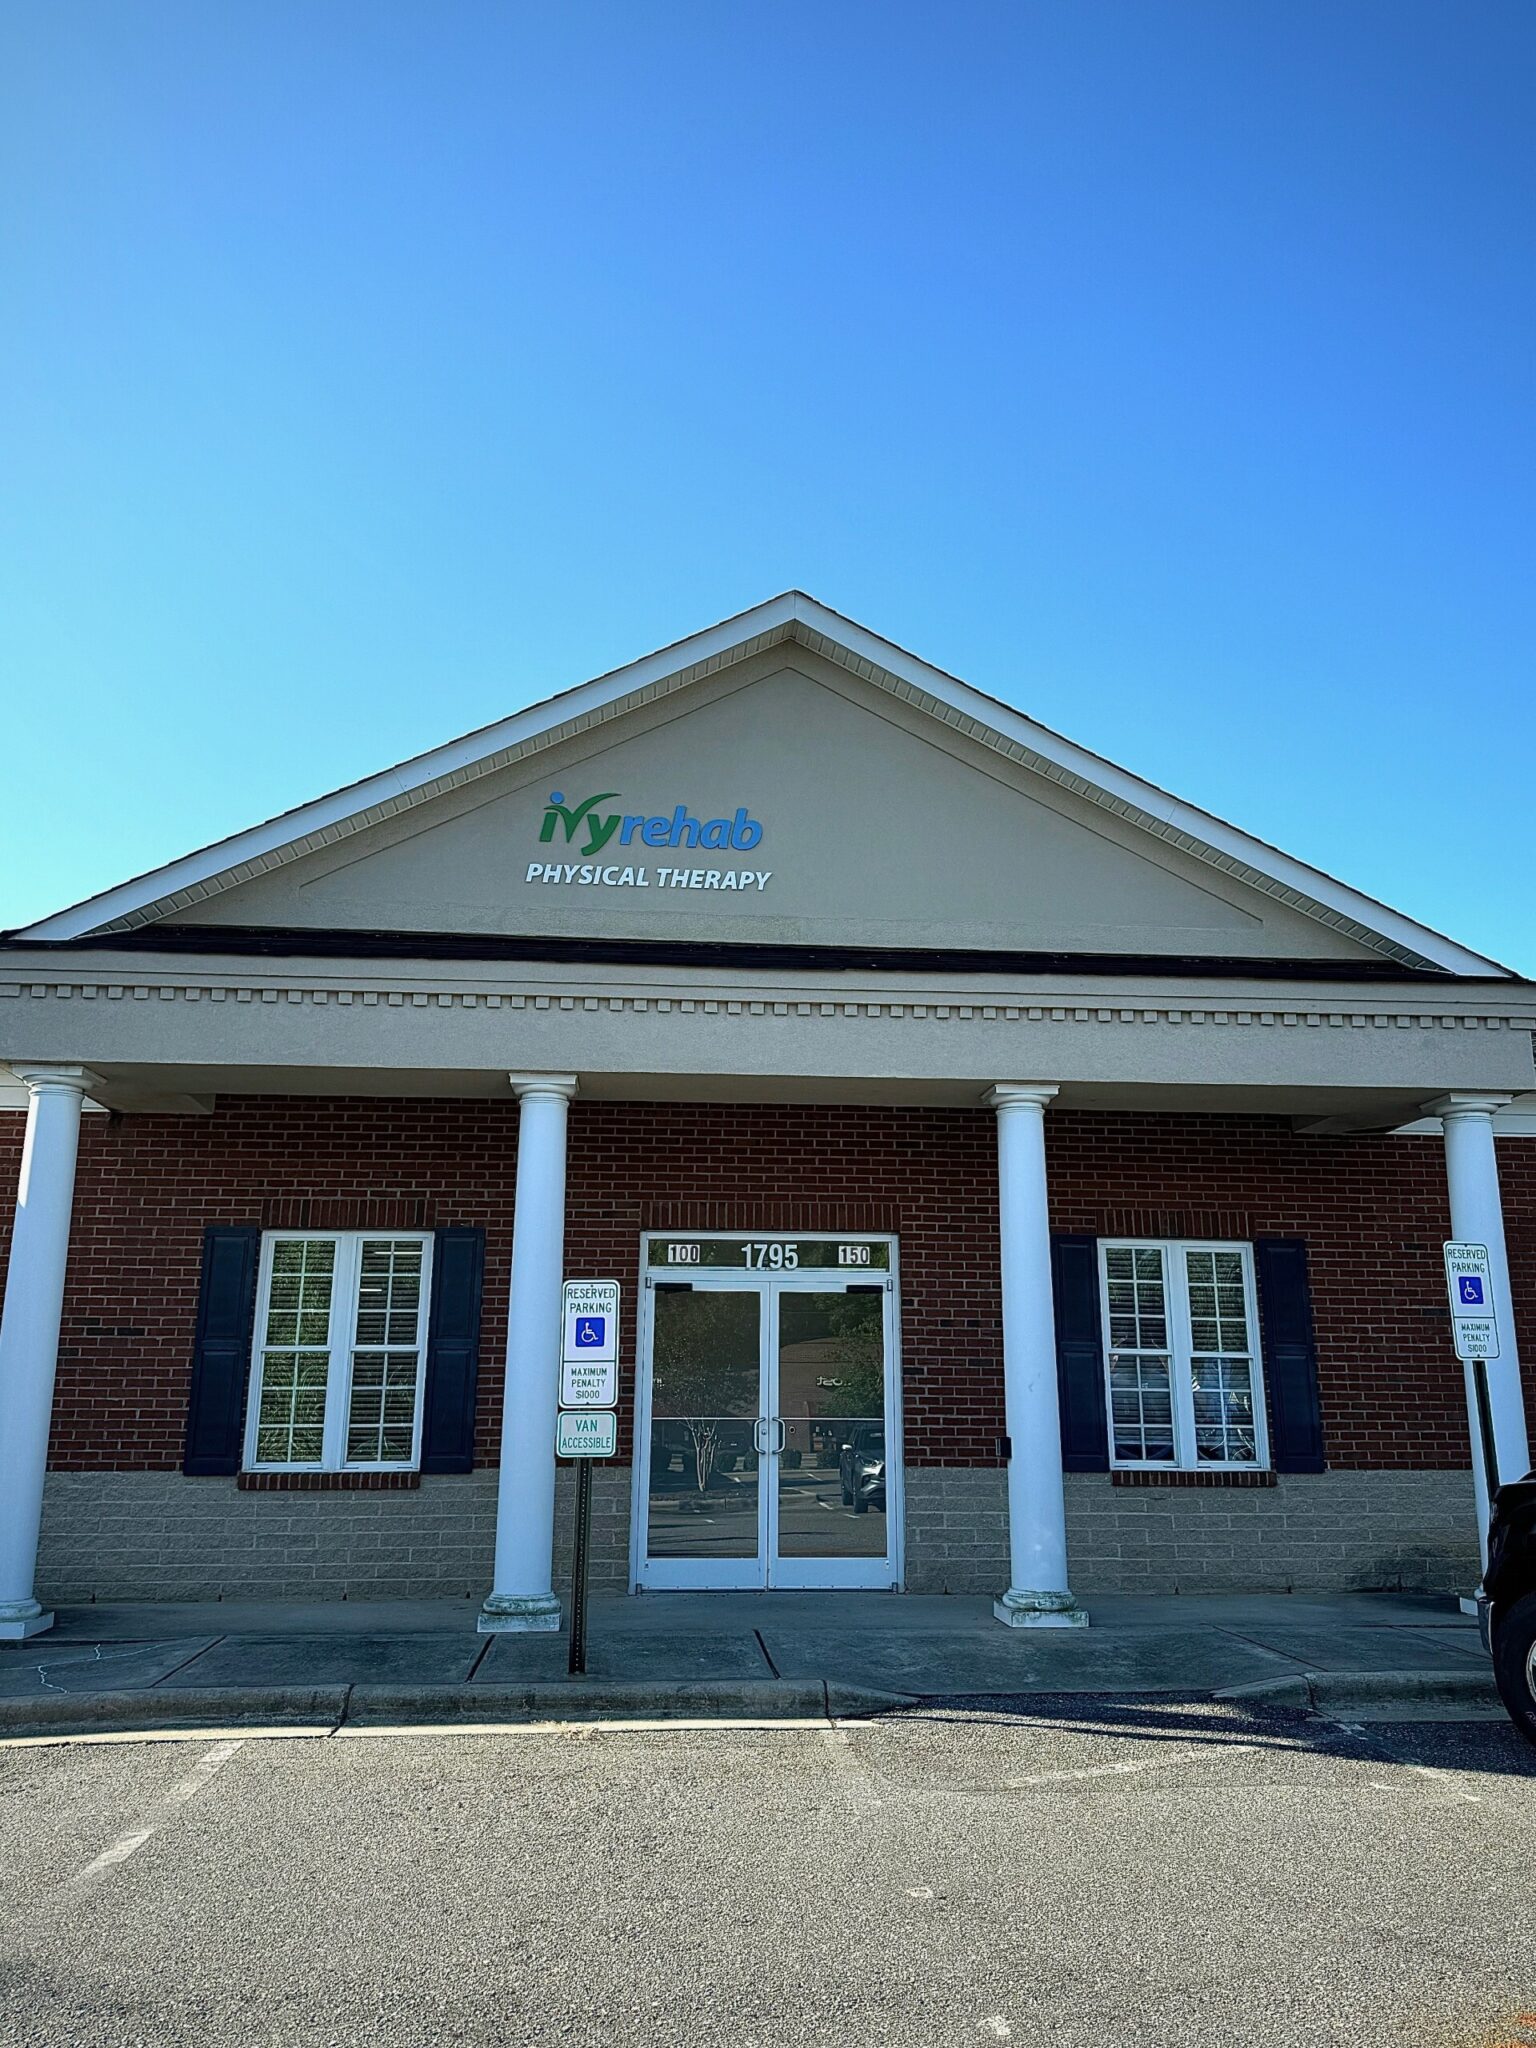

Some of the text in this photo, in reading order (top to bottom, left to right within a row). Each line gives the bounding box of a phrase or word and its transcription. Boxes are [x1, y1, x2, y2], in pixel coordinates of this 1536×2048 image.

[539, 791, 763, 856] ivyrehab
[525, 863, 772, 891] PHYSICAL THERAPY
[670, 1245, 699, 1262] 100
[741, 1243, 799, 1271] 1795
[840, 1247, 870, 1263] 150
[1447, 1248, 1486, 1259] RESERVED
[1451, 1262, 1485, 1273] PARKING
[567, 1288, 615, 1299] RESERVED
[569, 1302, 612, 1313] PARKING
[1461, 1323, 1490, 1331] MAXIMUM
[1463, 1333, 1490, 1342] PENALTY
[571, 1368, 608, 1376] MAXIMUM
[571, 1378, 606, 1387] PENALTY
[575, 1420, 598, 1432] VAN
[562, 1436, 611, 1449] ACCESSIBLE
